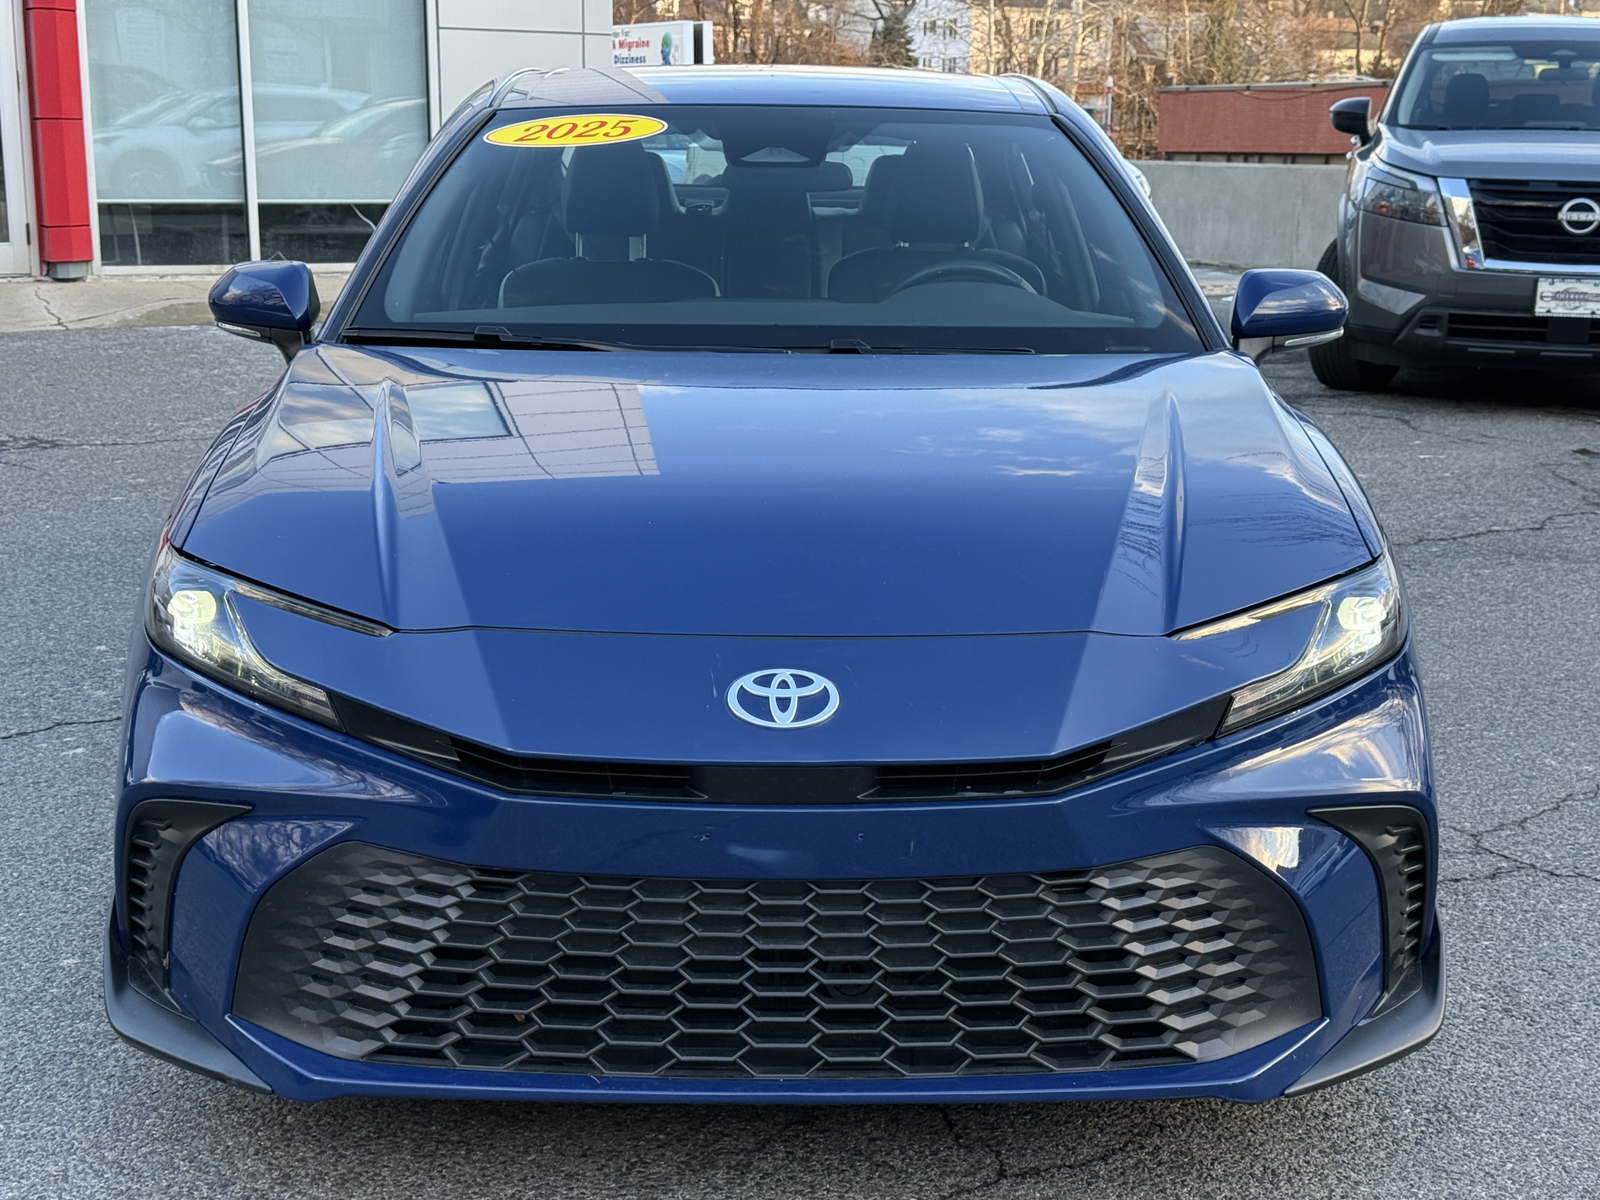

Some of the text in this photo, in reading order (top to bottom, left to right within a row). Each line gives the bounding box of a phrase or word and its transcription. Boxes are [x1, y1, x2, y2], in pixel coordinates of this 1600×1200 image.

[618, 38, 650, 51] Migraine
[614, 53, 646, 64] Dizziness
[513, 119, 639, 142] 2025
